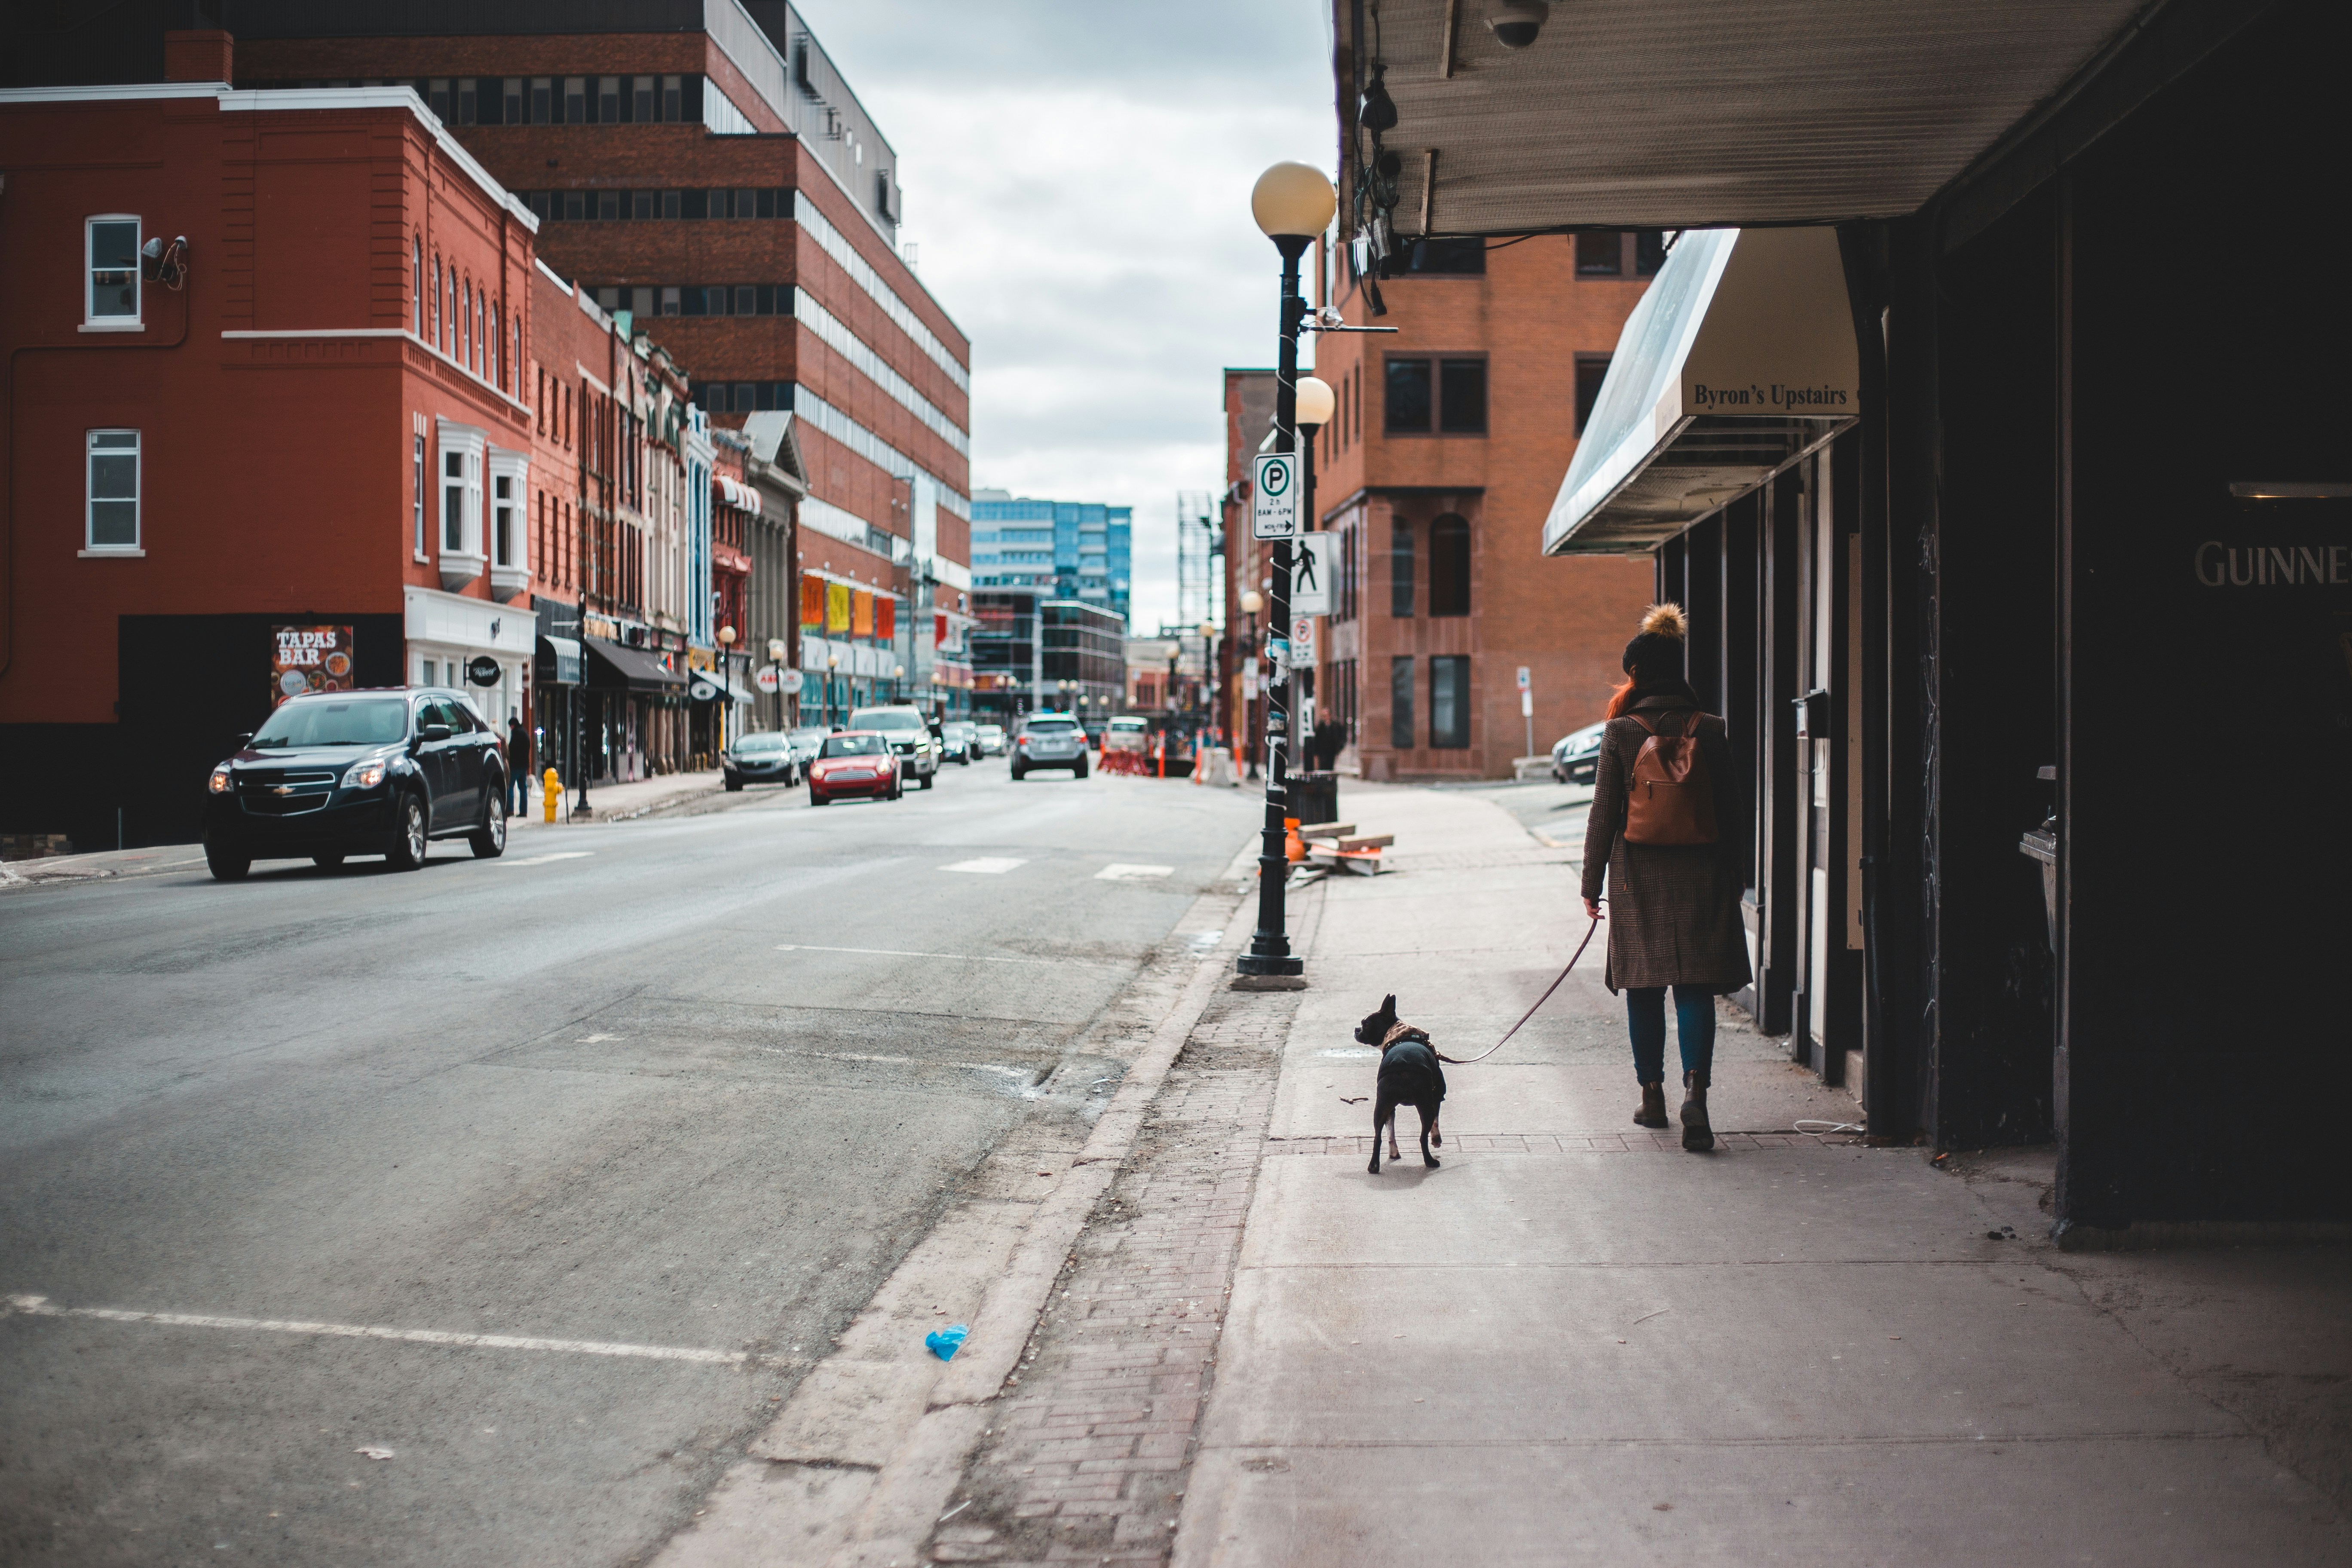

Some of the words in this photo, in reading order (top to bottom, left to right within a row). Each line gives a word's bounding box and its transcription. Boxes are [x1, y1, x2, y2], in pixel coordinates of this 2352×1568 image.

[1694, 384, 1765, 410] Byron's
[1770, 384, 1847, 410] Upstairs
[1269, 467, 1283, 489] P
[2194, 540, 2352, 586] GUINNE
[276, 631, 336, 649] TAPAS
[279, 648, 320, 665] BAR
